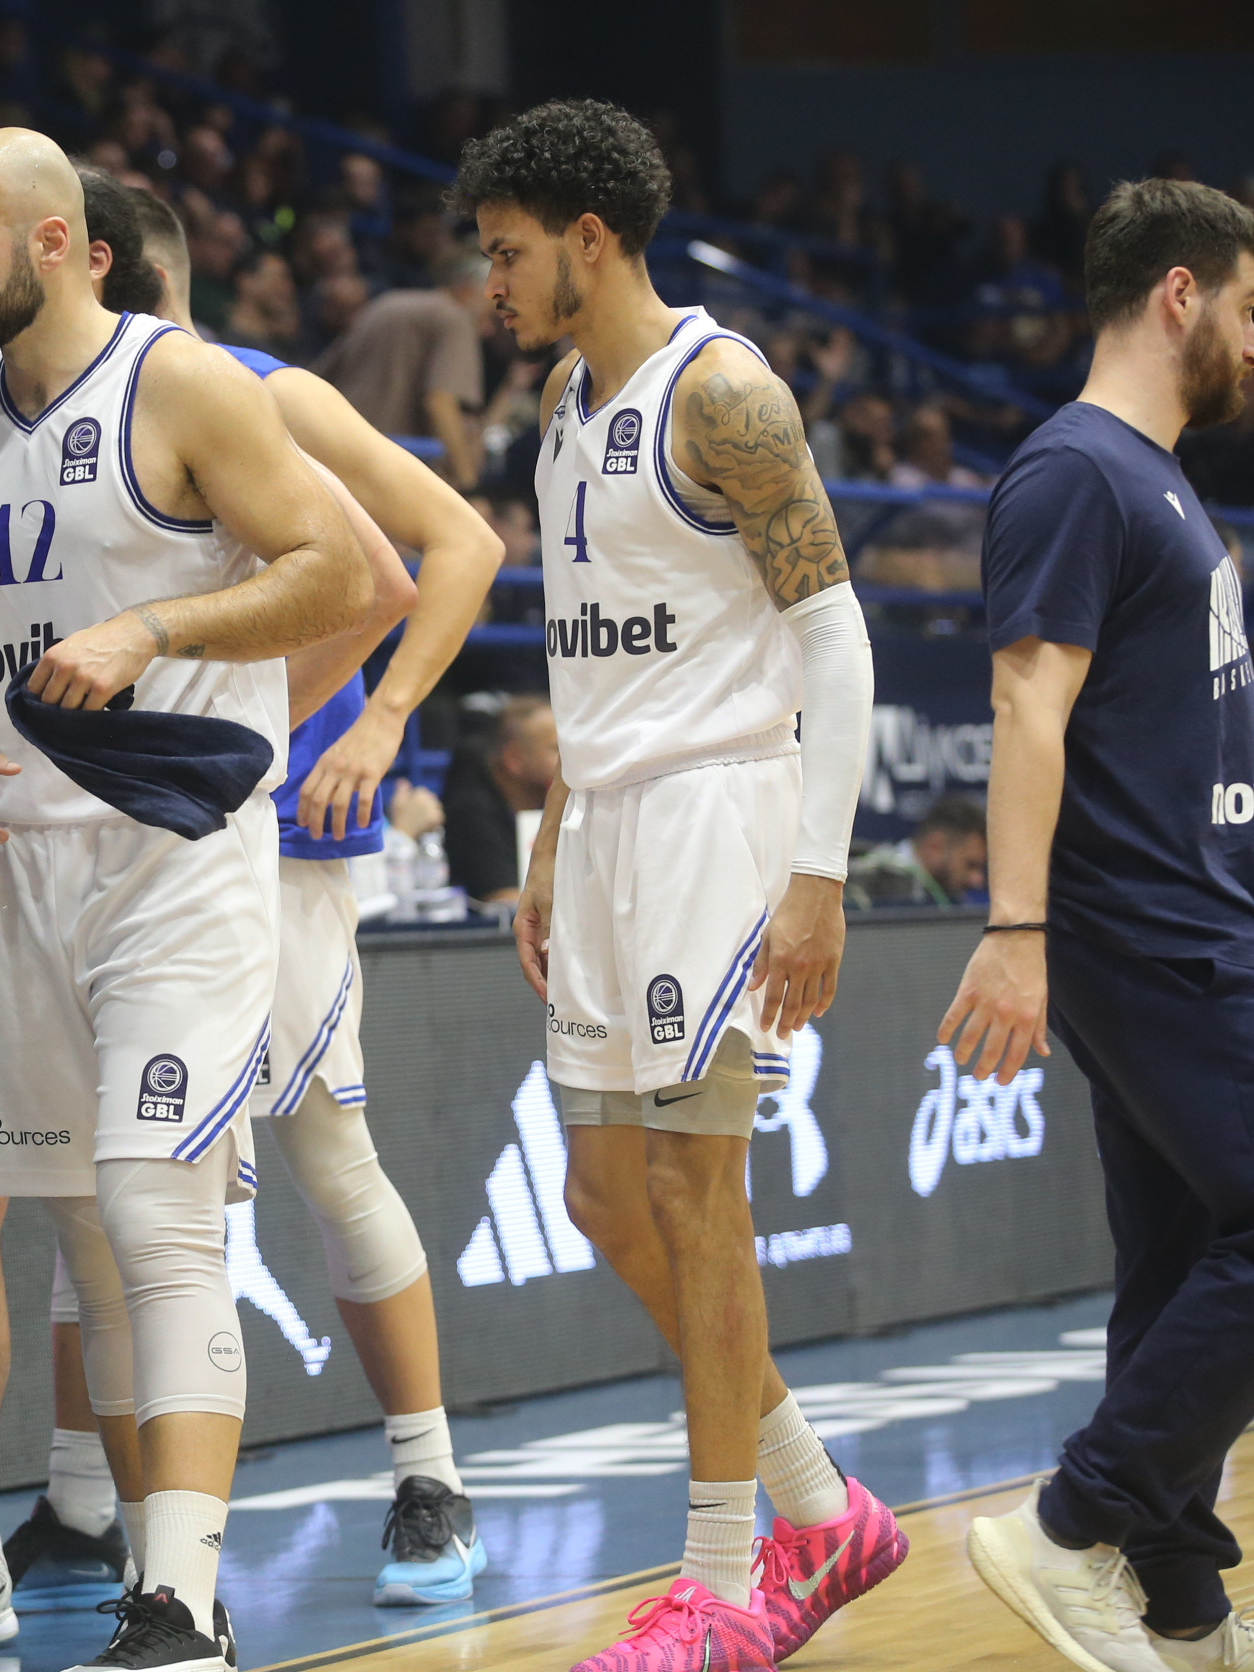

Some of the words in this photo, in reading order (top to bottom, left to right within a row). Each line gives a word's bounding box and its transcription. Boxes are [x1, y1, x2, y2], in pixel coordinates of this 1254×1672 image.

[606, 448, 638, 458] Stoiximan
[62, 457, 97, 468] Stoiximan
[606, 457, 635, 472] GBL
[63, 465, 94, 482] GBL
[564, 481, 592, 562] 4
[547, 602, 678, 658] ovibet
[651, 1015, 684, 1027] Stoiximan
[653, 1023, 684, 1041] GBL
[141, 1092, 184, 1105] Stoiximan
[140, 1102, 180, 1120] GBL
